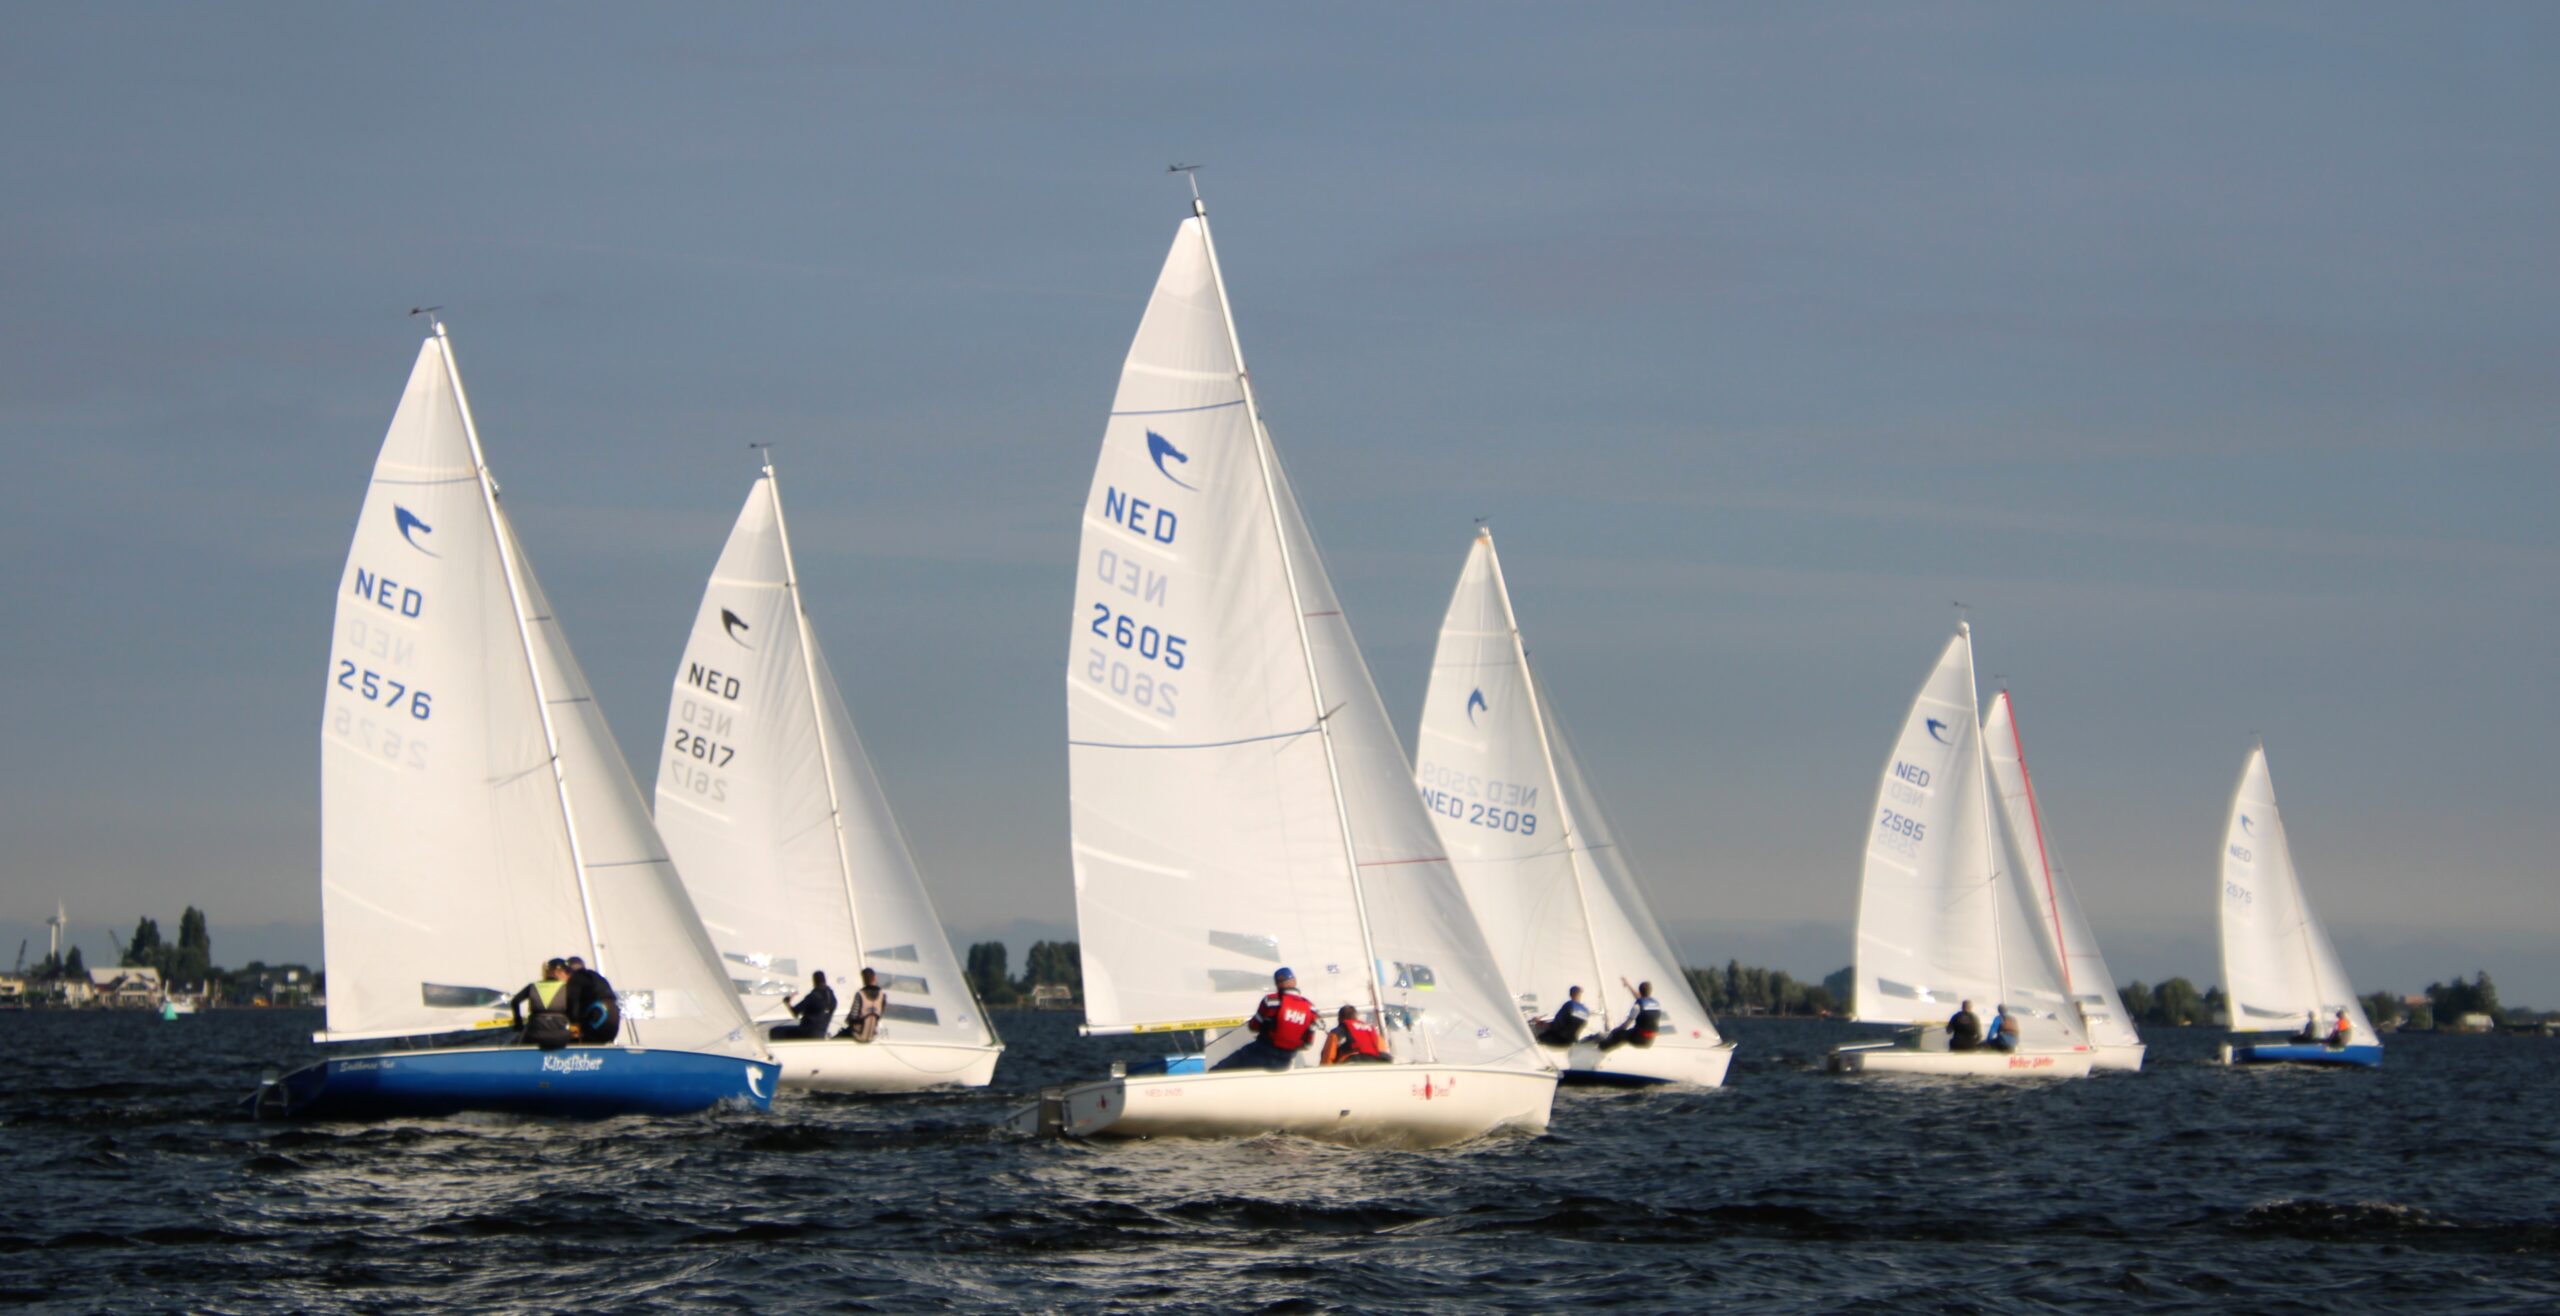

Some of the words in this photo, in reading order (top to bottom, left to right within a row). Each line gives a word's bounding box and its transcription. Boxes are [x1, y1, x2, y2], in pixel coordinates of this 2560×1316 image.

[1104, 485, 1177, 545] NED
[354, 567, 423, 618] NED
[1091, 602, 1187, 671] 2605
[337, 659, 432, 721] 2576
[688, 662, 741, 701] NED
[674, 728, 735, 768] 2617
[1896, 760, 1930, 787] NED
[1422, 786, 1464, 819] NED
[1469, 803, 1537, 836] 2509
[1881, 808, 1926, 841] 2595
[2230, 843, 2251, 862] NED
[1284, 1009, 1306, 1025] HH
[542, 1054, 603, 1075] Kingfisher
